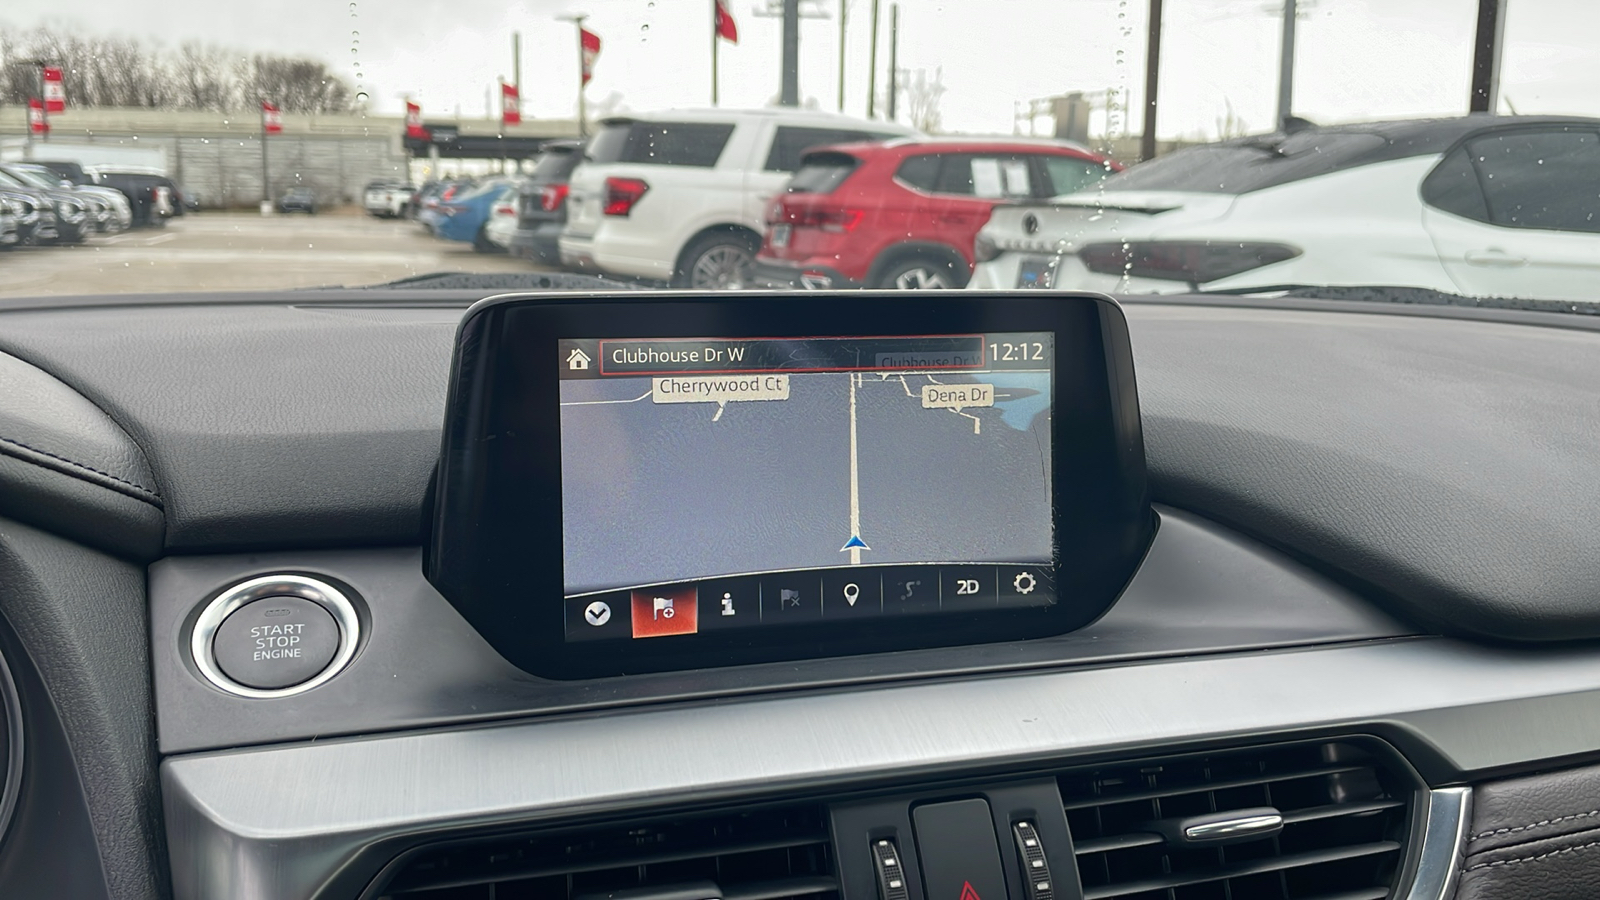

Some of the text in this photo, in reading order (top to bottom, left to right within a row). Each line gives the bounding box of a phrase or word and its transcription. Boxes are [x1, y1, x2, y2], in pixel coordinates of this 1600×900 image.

[612, 347, 745, 364] Clubhouse Dr W
[989, 342, 1044, 361] 12:12
[660, 376, 782, 396] Cherrywood Ct
[928, 387, 988, 403] Dena Dr
[956, 579, 979, 595] 2D
[250, 623, 305, 638] START
[255, 635, 300, 650] STOP
[253, 648, 302, 661] ENGINE
